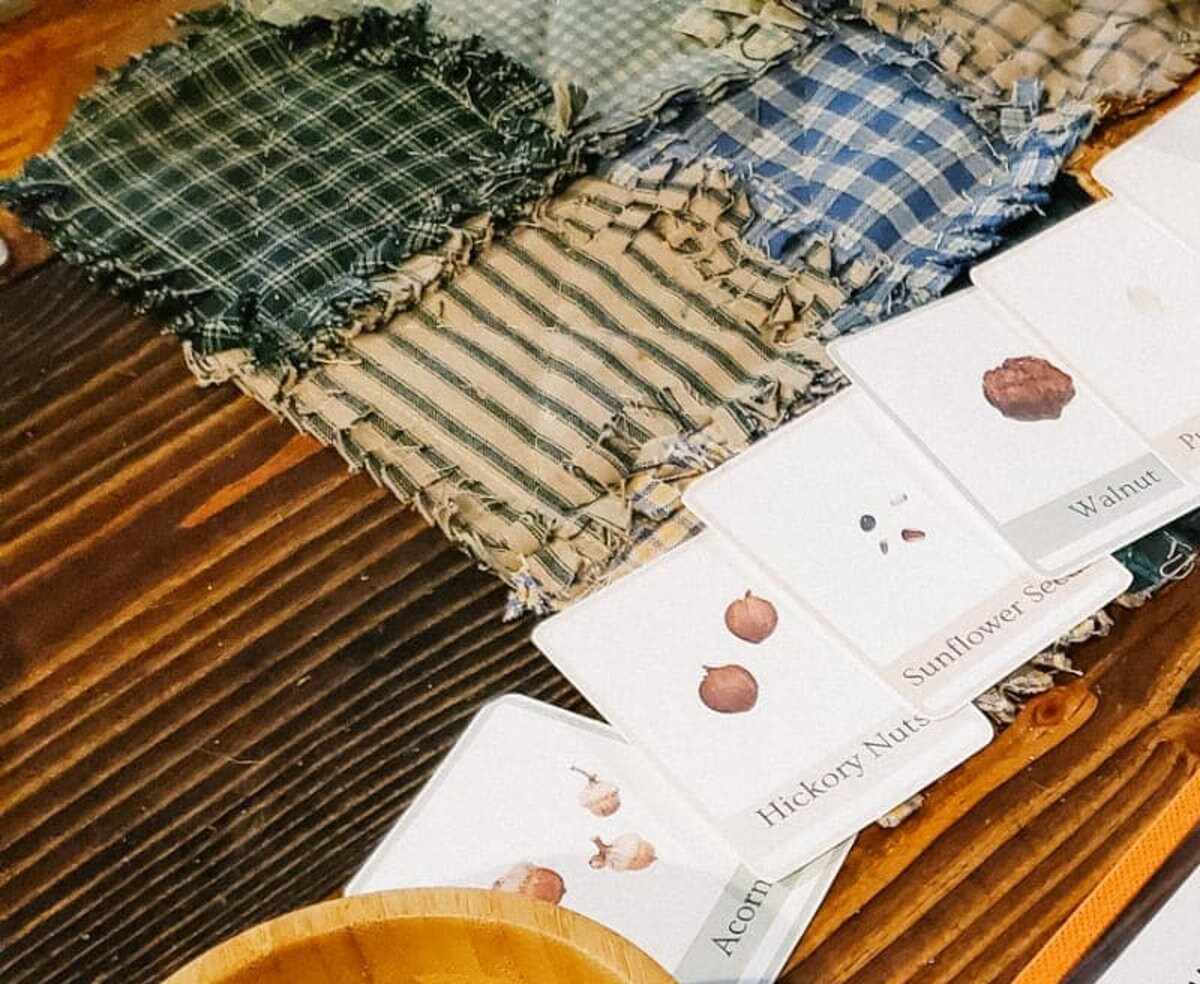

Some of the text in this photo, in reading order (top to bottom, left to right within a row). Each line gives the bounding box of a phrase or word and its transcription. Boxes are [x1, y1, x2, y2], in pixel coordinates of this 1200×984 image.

[1068, 467, 1162, 519] Walnut
[902, 601, 1024, 687] Sunflower
[756, 714, 932, 828] Hickory Nuts
[711, 879, 773, 957] Acorn
